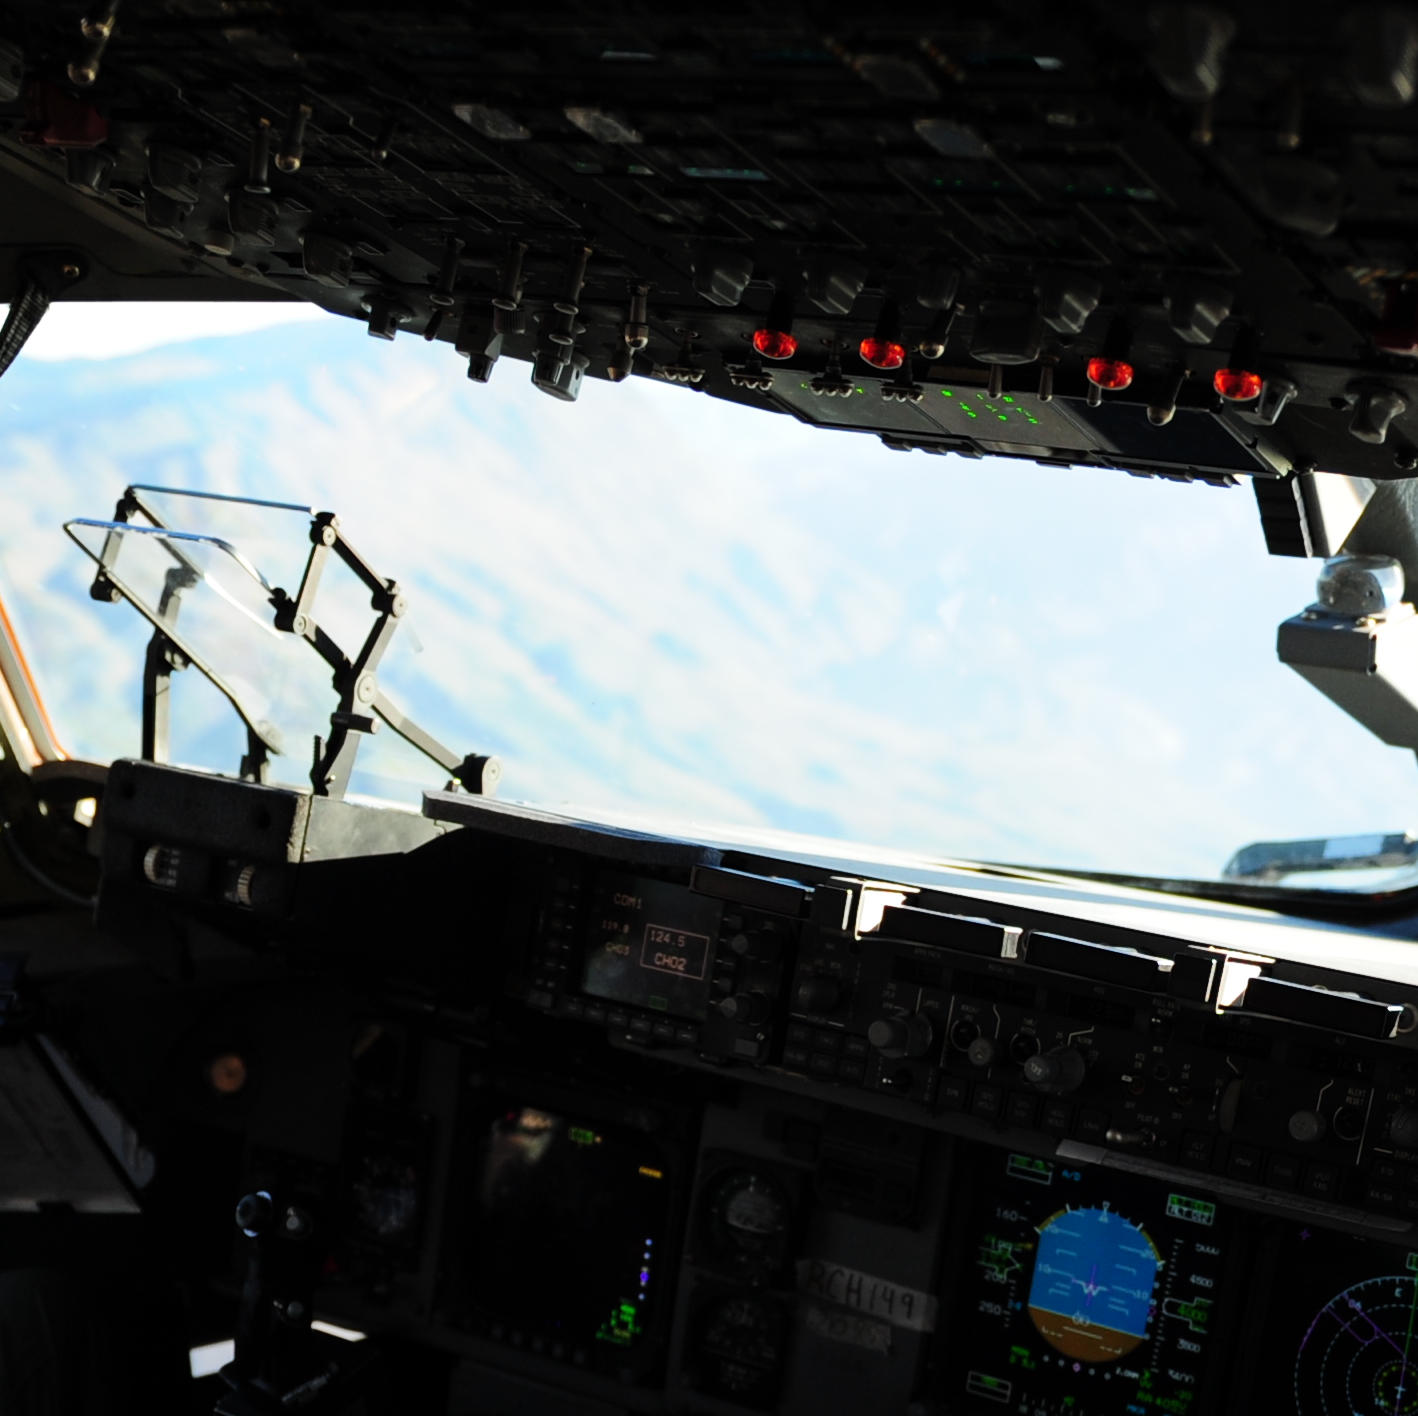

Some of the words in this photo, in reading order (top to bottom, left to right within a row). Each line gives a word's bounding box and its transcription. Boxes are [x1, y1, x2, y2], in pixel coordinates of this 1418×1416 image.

[614, 893, 642, 909] COM1
[650, 929, 685, 947] 124.5
[654, 953, 687, 971] CH02
[1345, 1095, 1364, 1106] RESET
[1347, 1087, 1366, 1098] ALERT
[979, 1300, 1001, 1316] 250
